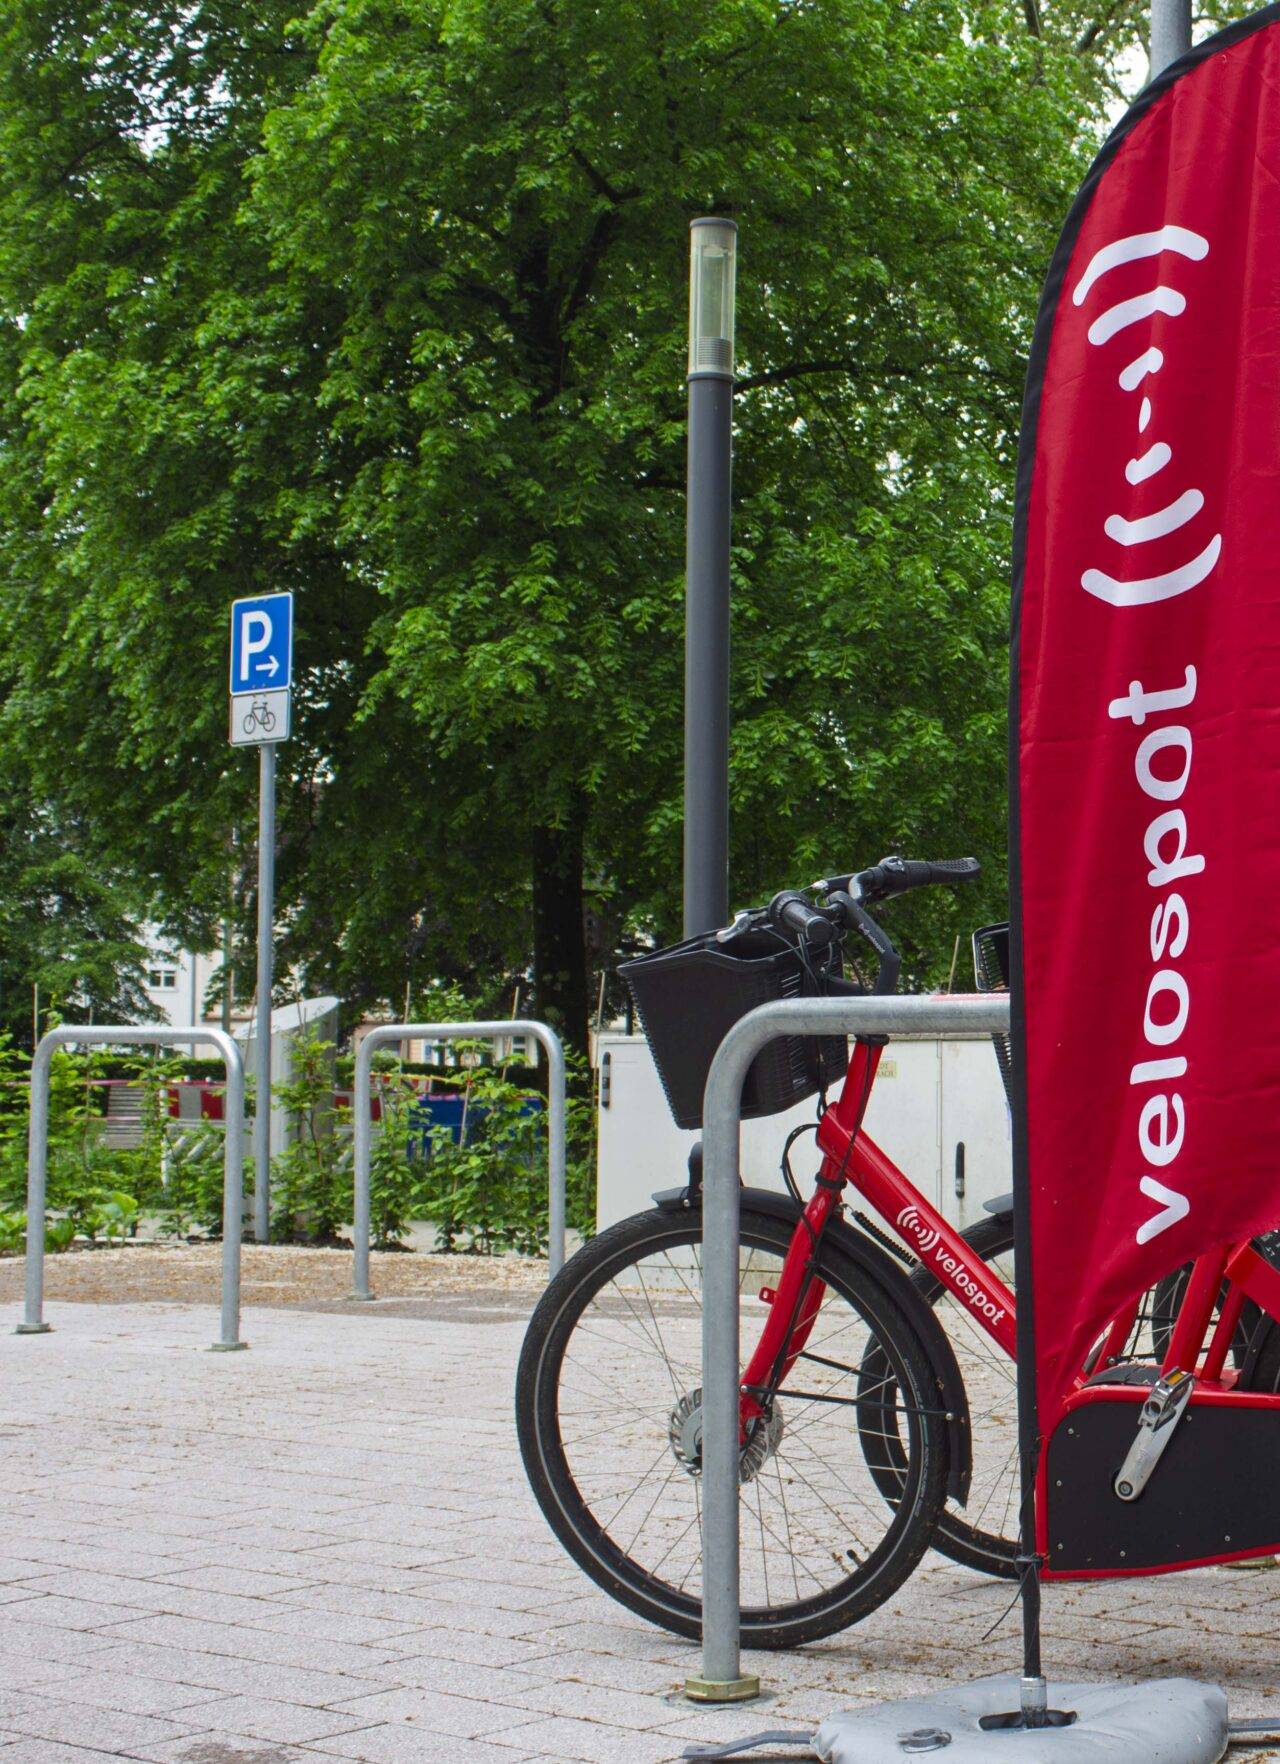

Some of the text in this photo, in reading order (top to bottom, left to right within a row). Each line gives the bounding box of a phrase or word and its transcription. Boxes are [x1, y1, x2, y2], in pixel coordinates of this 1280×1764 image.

[241, 611, 273, 681] P
[1108, 664, 1206, 1245] velospot
[935, 1247, 1006, 1326] velospot
